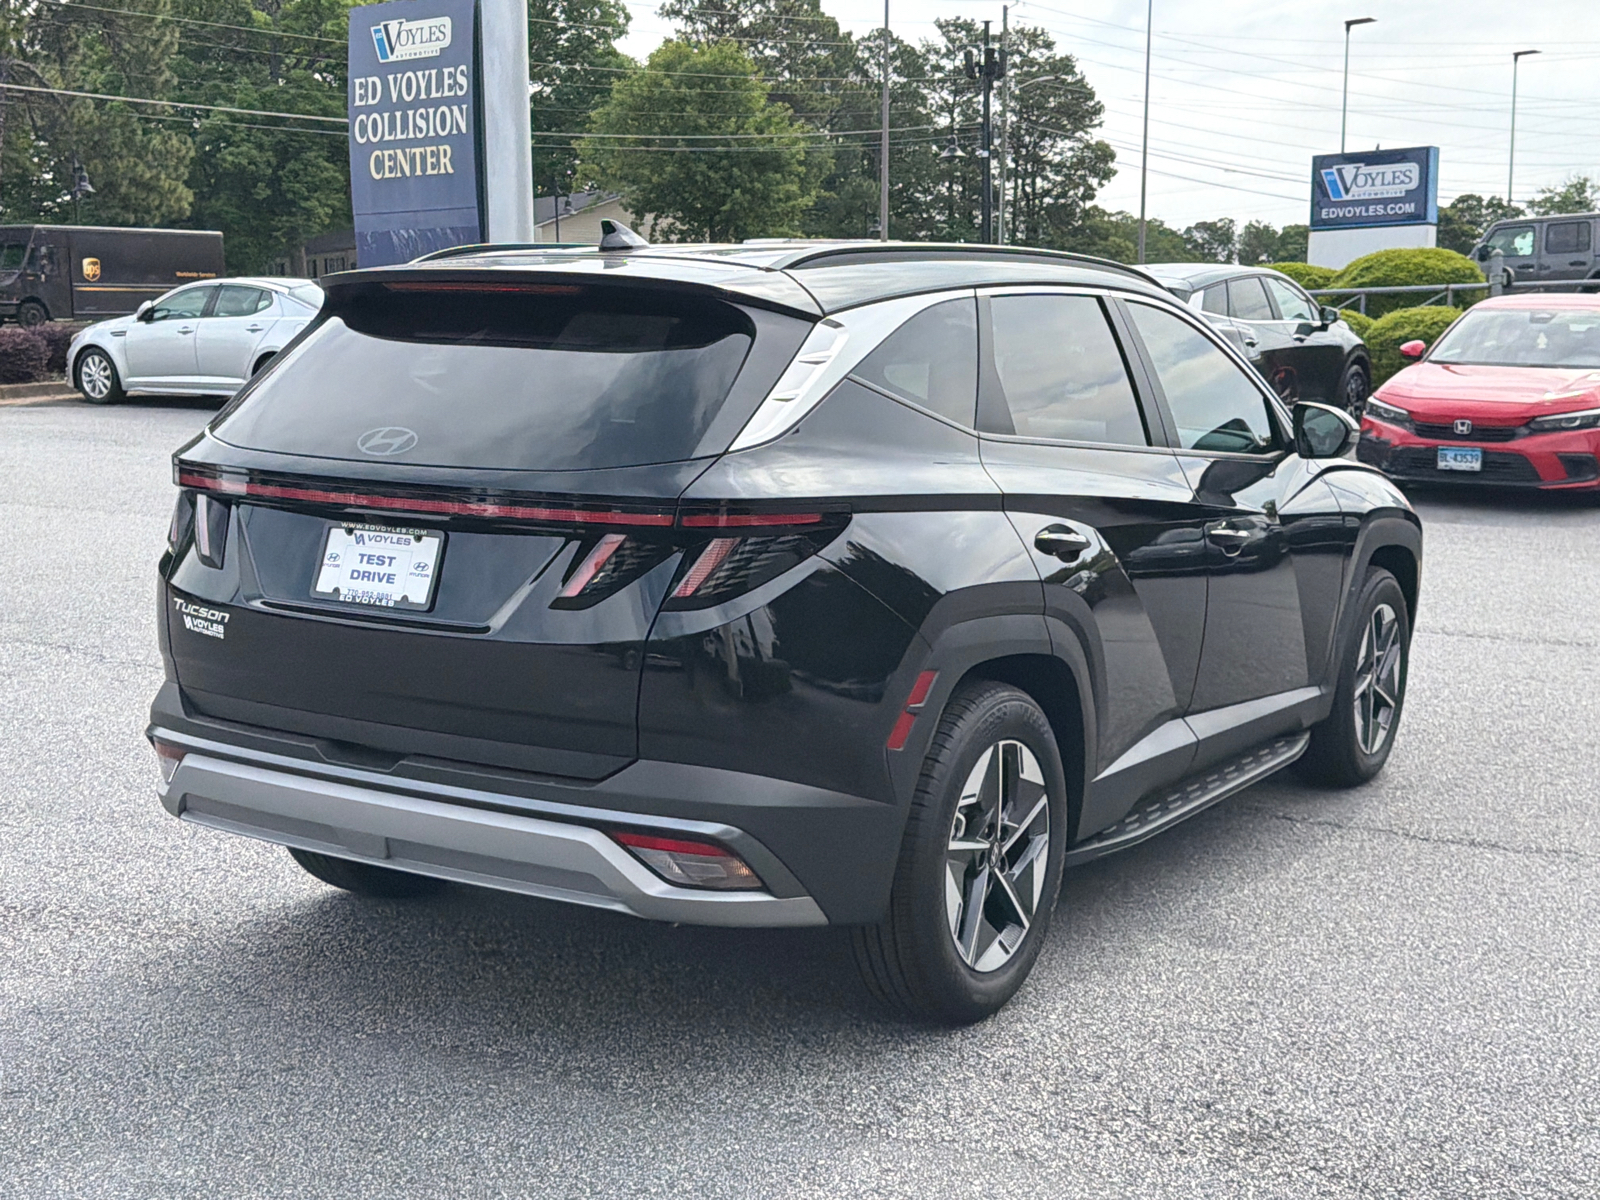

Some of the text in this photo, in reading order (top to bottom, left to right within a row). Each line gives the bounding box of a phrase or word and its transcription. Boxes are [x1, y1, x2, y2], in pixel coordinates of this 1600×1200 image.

[395, 48, 439, 59] AUTOMOTIVE
[353, 64, 468, 107] ED VOYLES
[354, 104, 468, 144] COLLISION
[369, 144, 454, 180] CENTER
[1321, 202, 1415, 219] EDVOYLES.COM
[367, 534, 412, 546] VOYLES
[358, 552, 397, 568] TEST
[349, 569, 397, 585] DRIVE
[355, 595, 395, 608] VOYLES
[193, 617, 224, 633] VOYLES
